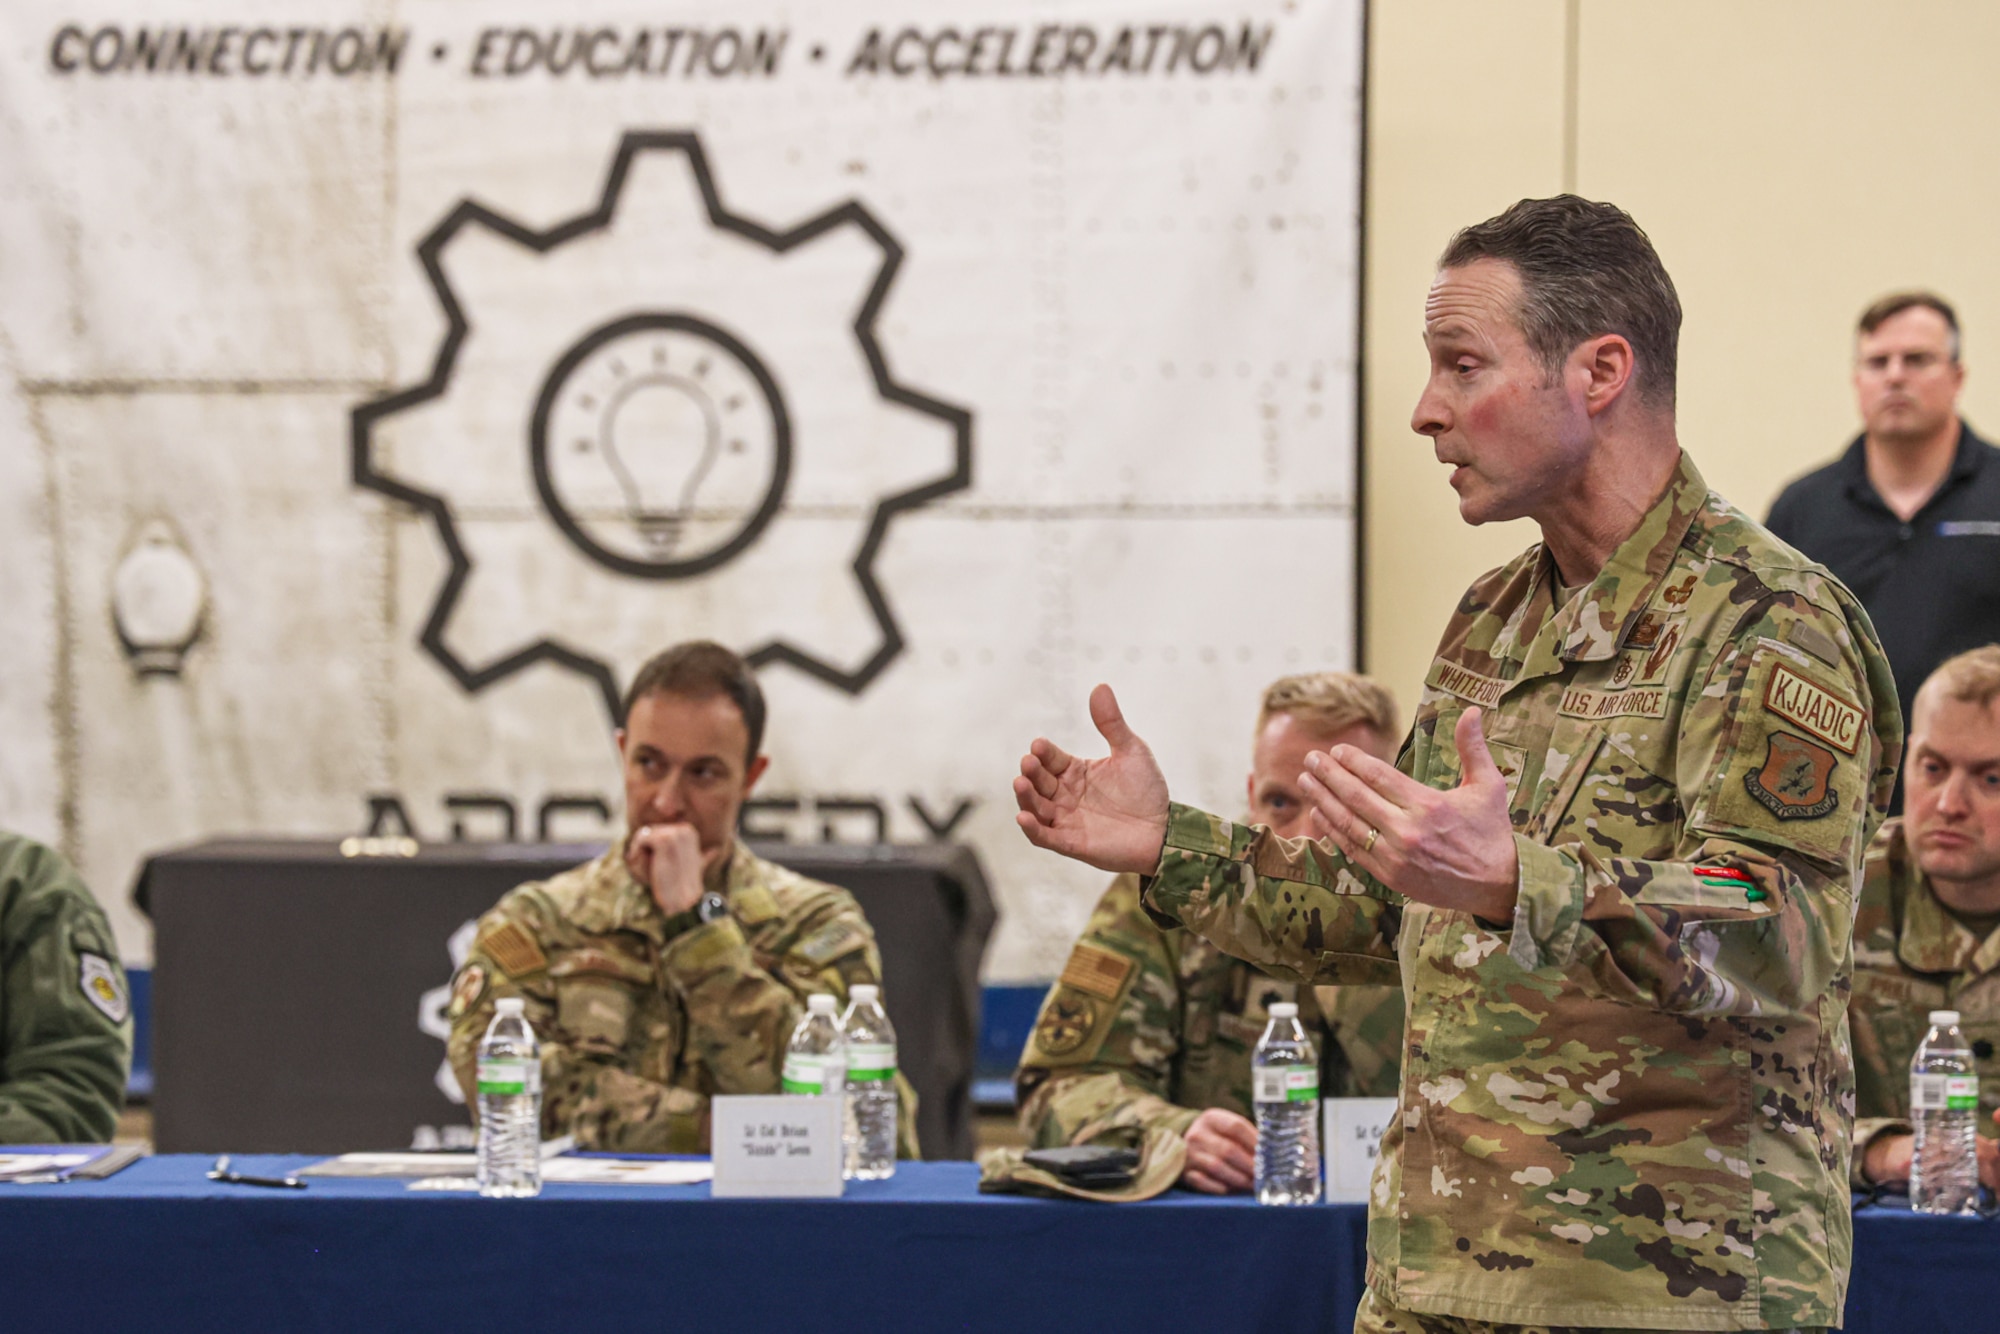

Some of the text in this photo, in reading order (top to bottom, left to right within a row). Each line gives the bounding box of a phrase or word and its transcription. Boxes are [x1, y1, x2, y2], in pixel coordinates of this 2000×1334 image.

[50, 22, 1274, 77] CONNECTION EDUCATION ACCELERATION
[1436, 663, 1504, 704] WHITEFOOT
[1561, 690, 1663, 716] U.S. AIR FORCE
[1773, 673, 1854, 742] KJJADIC
[1758, 789, 1809, 817] MICHIGAN
